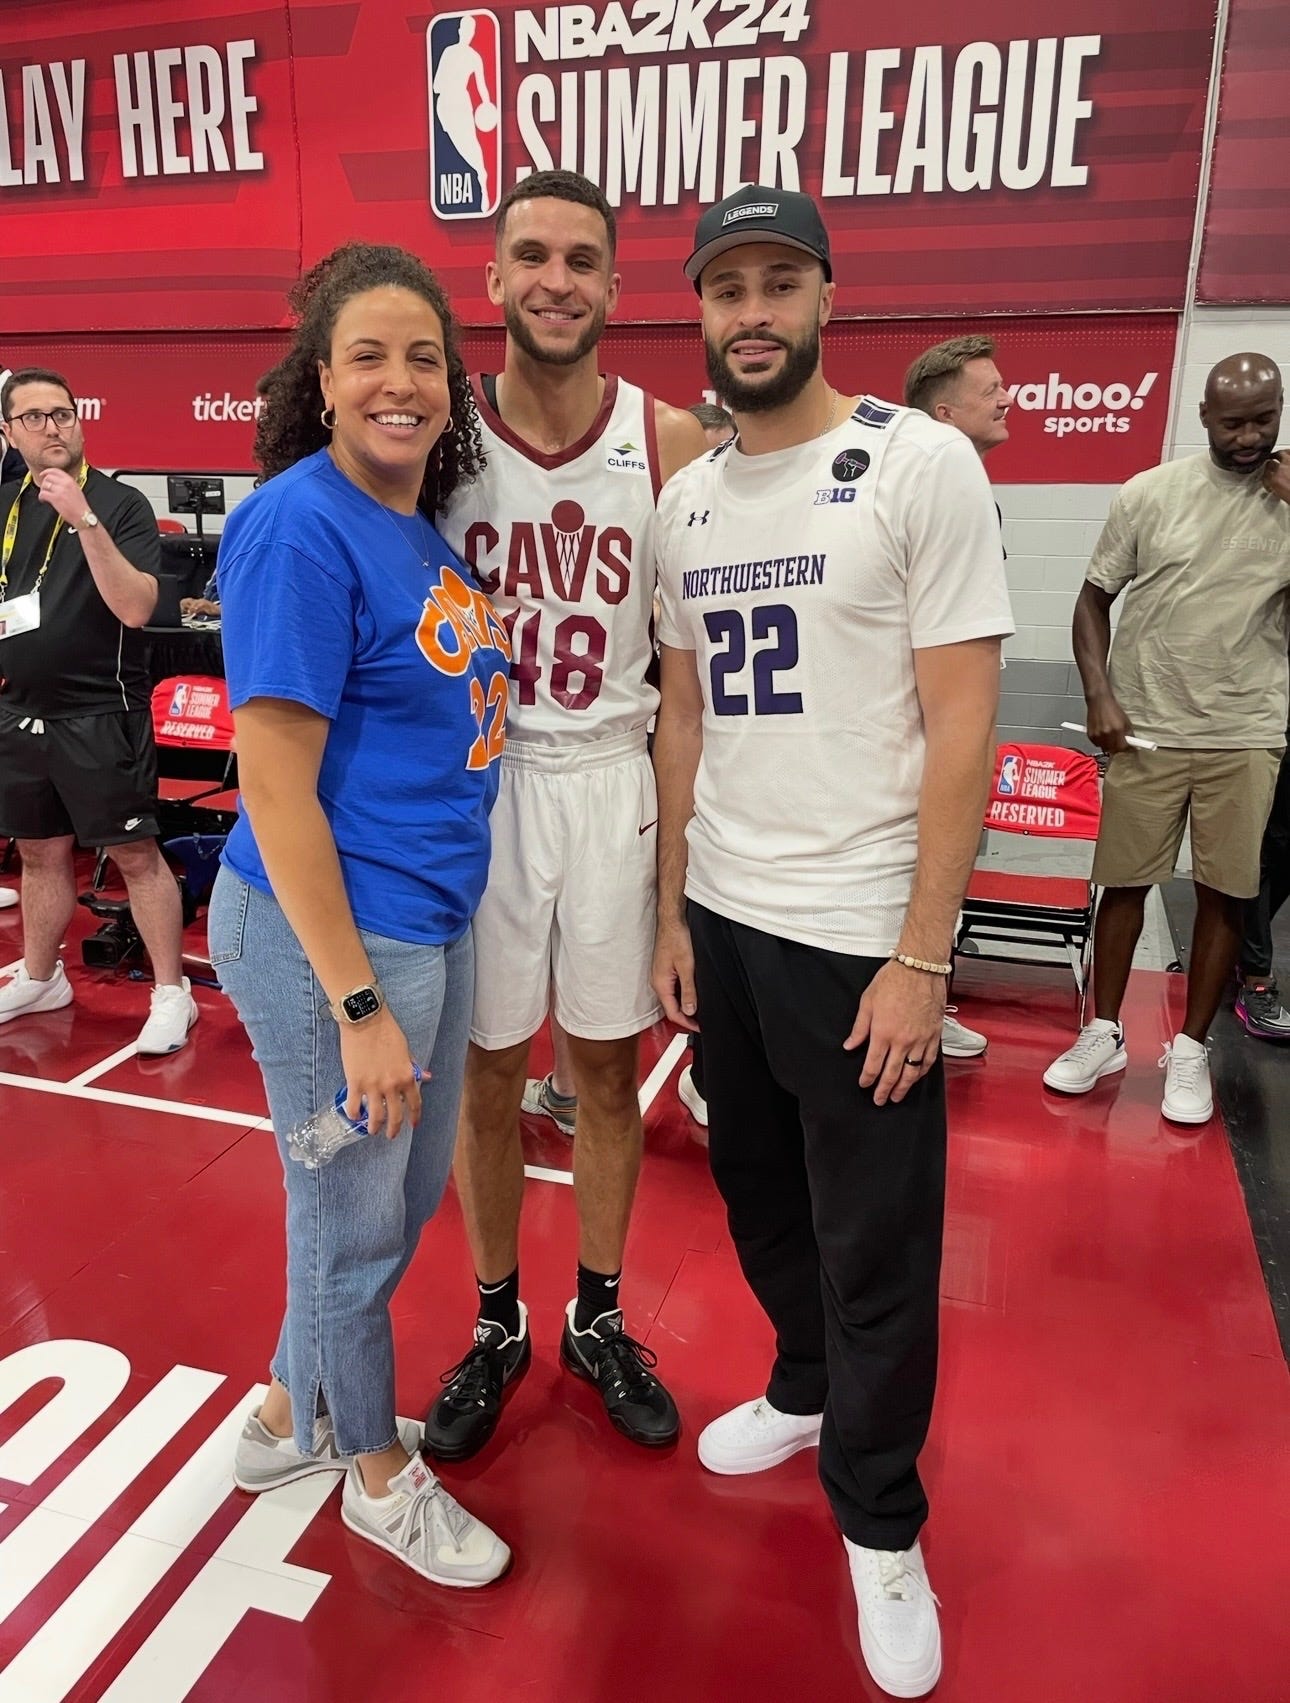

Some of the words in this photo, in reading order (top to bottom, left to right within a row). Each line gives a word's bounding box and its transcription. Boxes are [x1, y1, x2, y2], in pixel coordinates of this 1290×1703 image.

[514, 0, 811, 63] NBA2K24
[113, 39, 264, 178] HERE
[514, 55, 807, 207] SUMMER
[822, 34, 1101, 197] LEAGUE
[440, 172, 474, 205] NBA
[727, 205, 774, 221] LEGENDS
[1043, 412, 1131, 438] sports
[607, 457, 646, 470] CLIFFS
[464, 508, 632, 605] CAVS
[682, 554, 827, 600] NORTHWESTERN
[502, 606, 607, 710] 48
[702, 603, 804, 716] 22
[465, 671, 510, 770] 22
[1021, 783, 1057, 800] LEAGUE
[1024, 767, 1065, 785] SUMMER
[990, 801, 1065, 827] RESERVED
